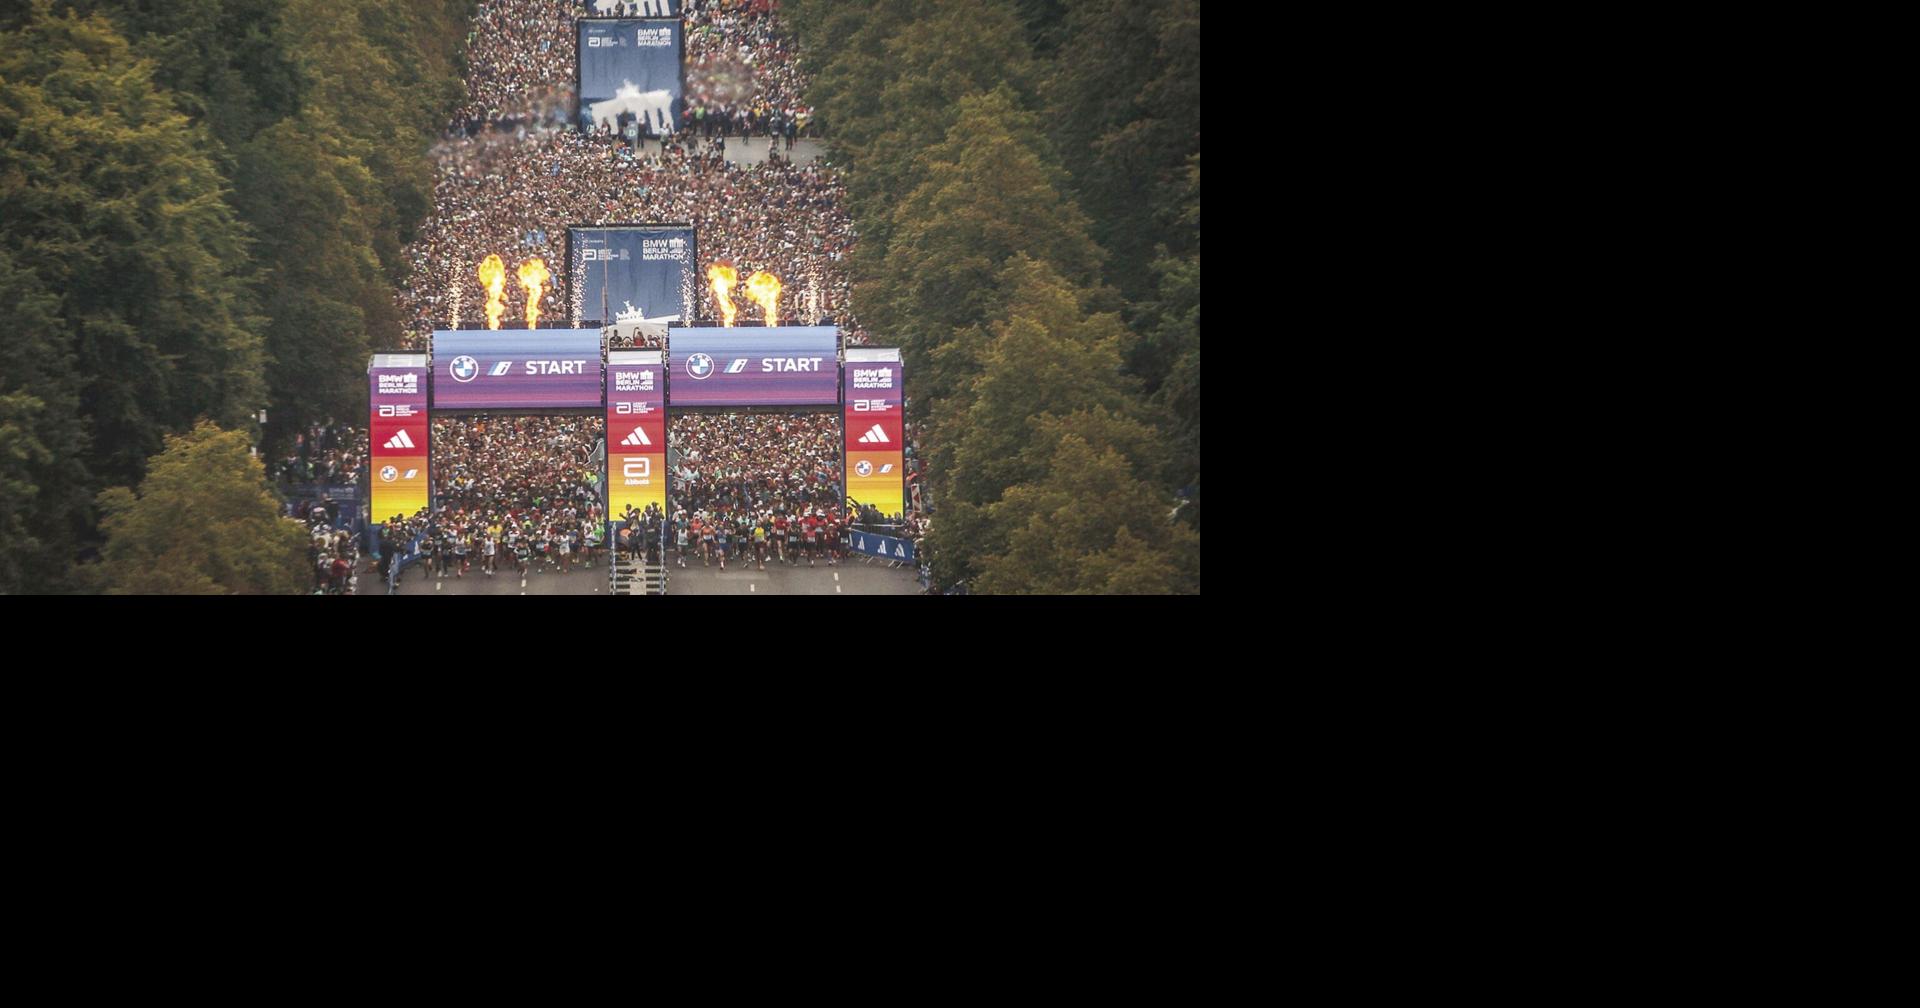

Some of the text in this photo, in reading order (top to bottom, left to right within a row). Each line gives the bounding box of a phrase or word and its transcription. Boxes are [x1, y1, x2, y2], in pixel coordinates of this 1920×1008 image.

[525, 360, 586, 375] START
[761, 357, 822, 373] START
[615, 372, 640, 380] BMW
[853, 369, 878, 378] BMW
